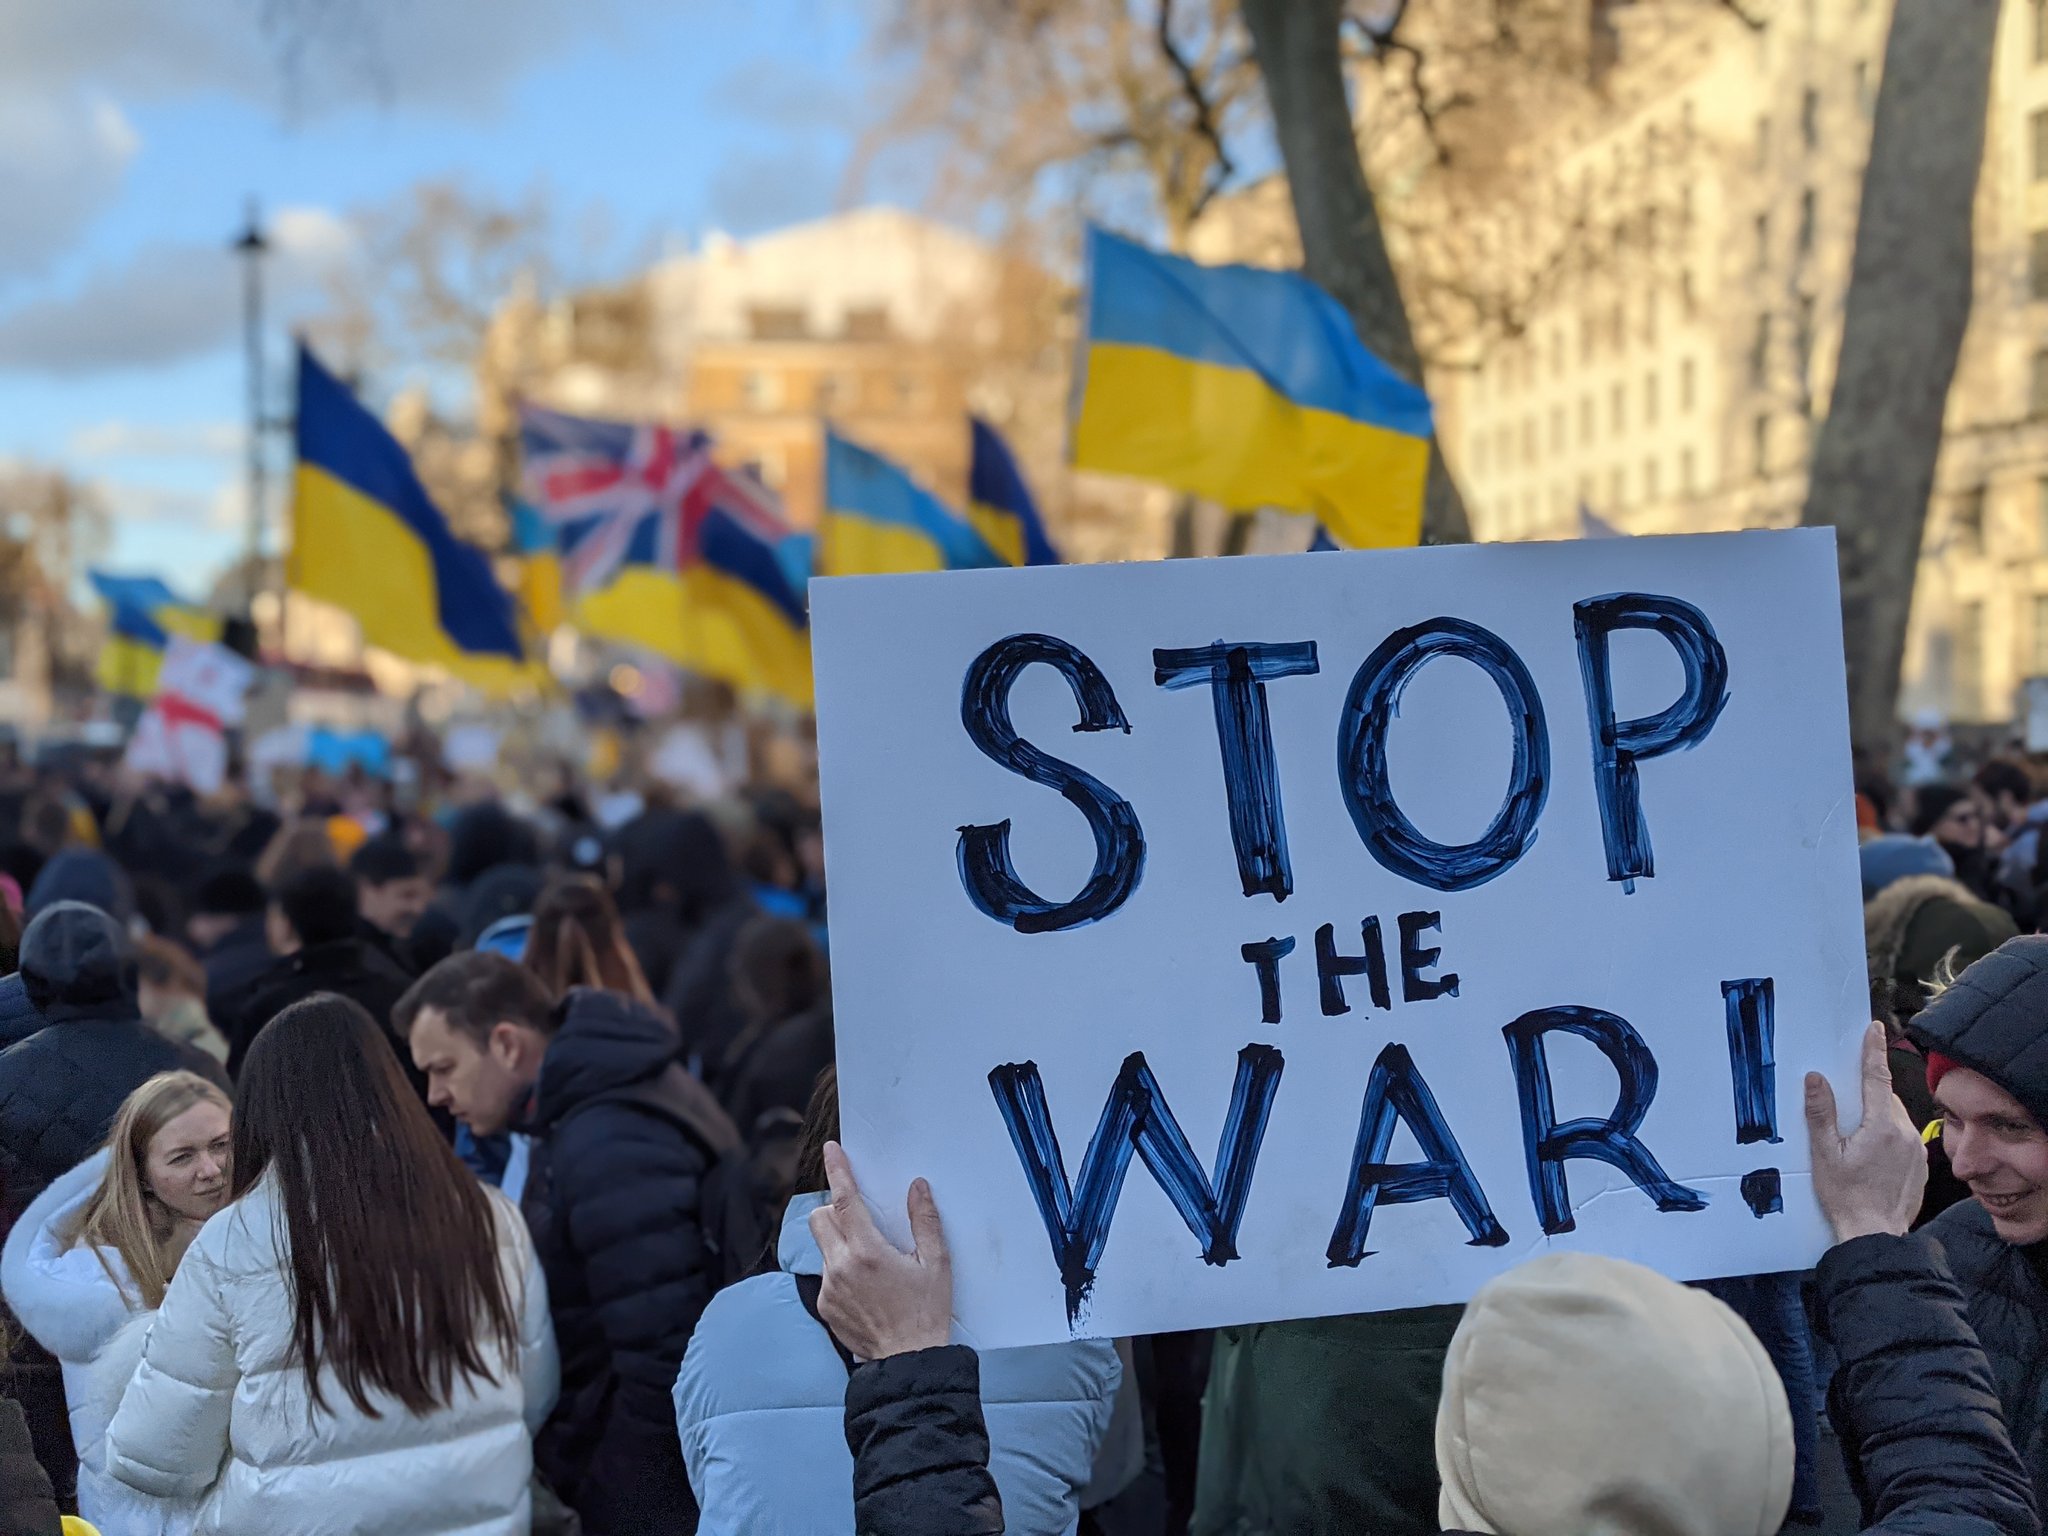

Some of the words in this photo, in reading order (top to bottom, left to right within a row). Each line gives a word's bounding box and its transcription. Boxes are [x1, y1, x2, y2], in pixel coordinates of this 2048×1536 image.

[955, 592, 1733, 935] STOP
[1241, 911, 1461, 1024] THE
[987, 977, 1785, 1333] WAR!
